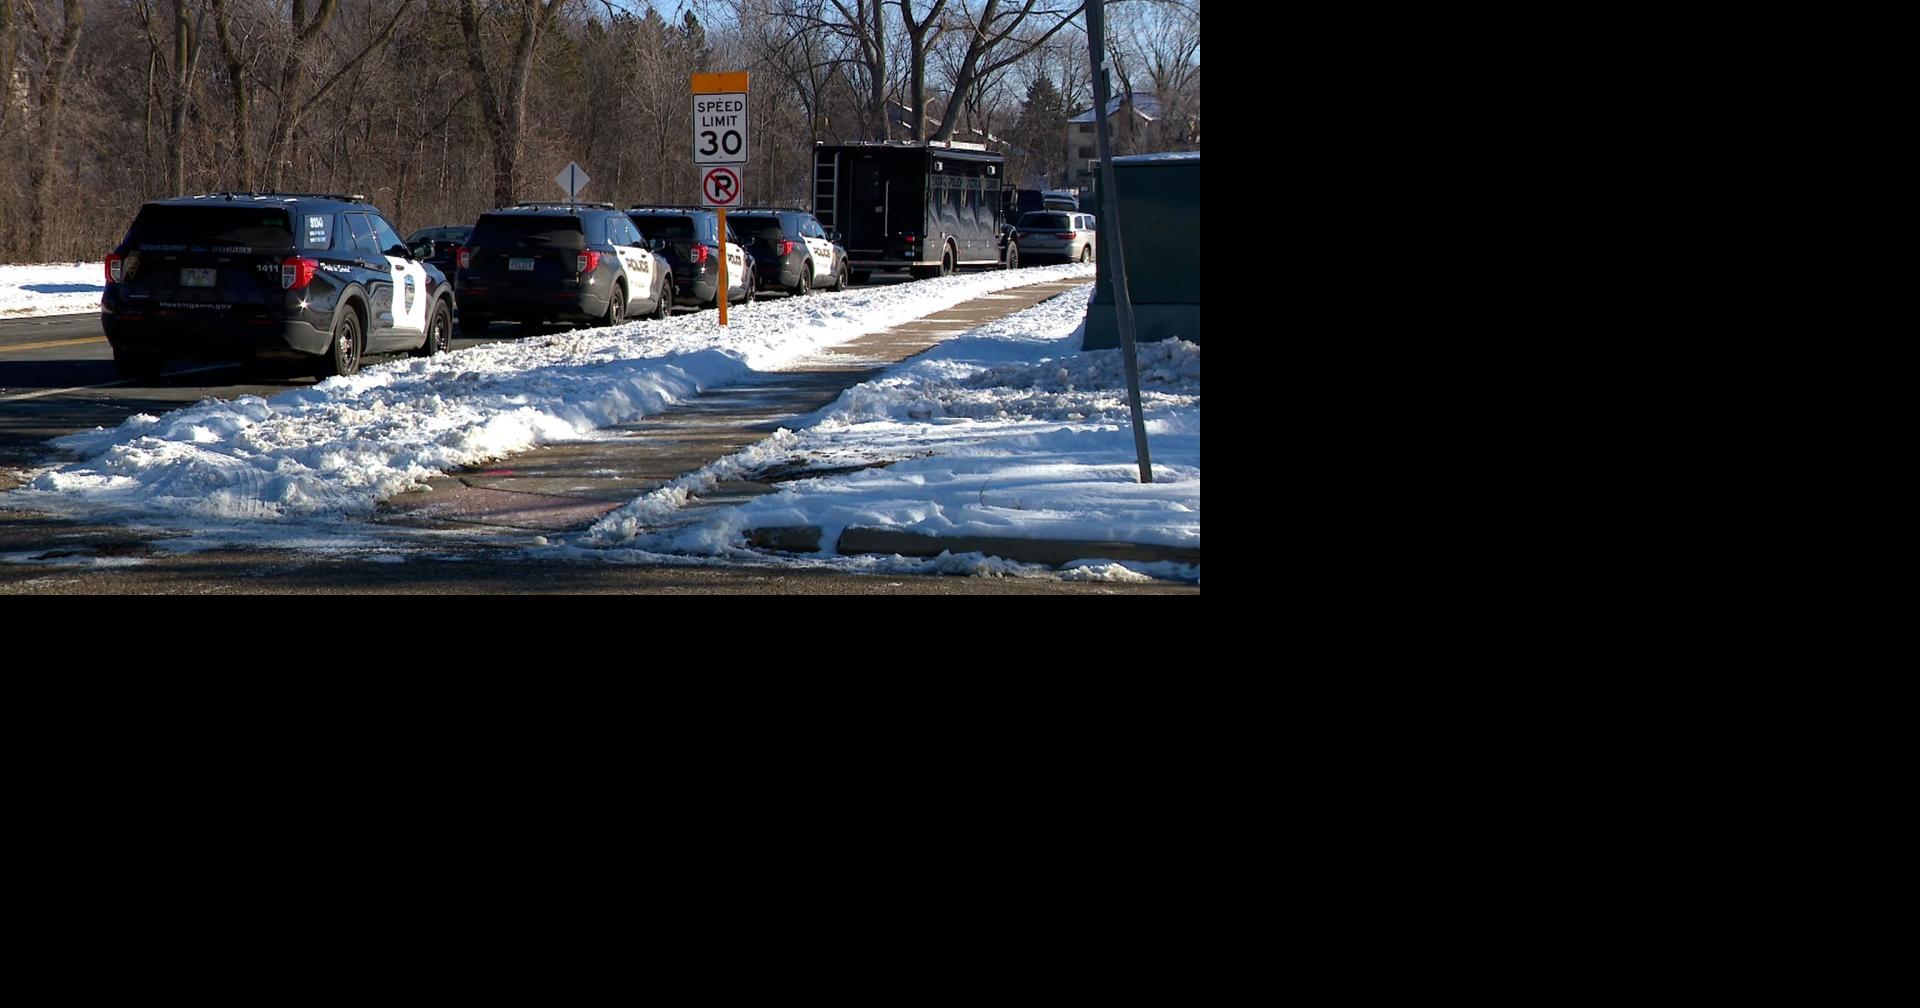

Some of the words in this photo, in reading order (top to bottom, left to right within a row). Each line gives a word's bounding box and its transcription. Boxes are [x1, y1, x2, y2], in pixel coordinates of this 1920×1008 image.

[697, 101, 743, 113] SPEED
[702, 115, 738, 127] LIMIT
[699, 130, 742, 156] 30
[812, 246, 831, 259] POLICE
[256, 264, 279, 274] 1411
[625, 257, 649, 273] POLICE
